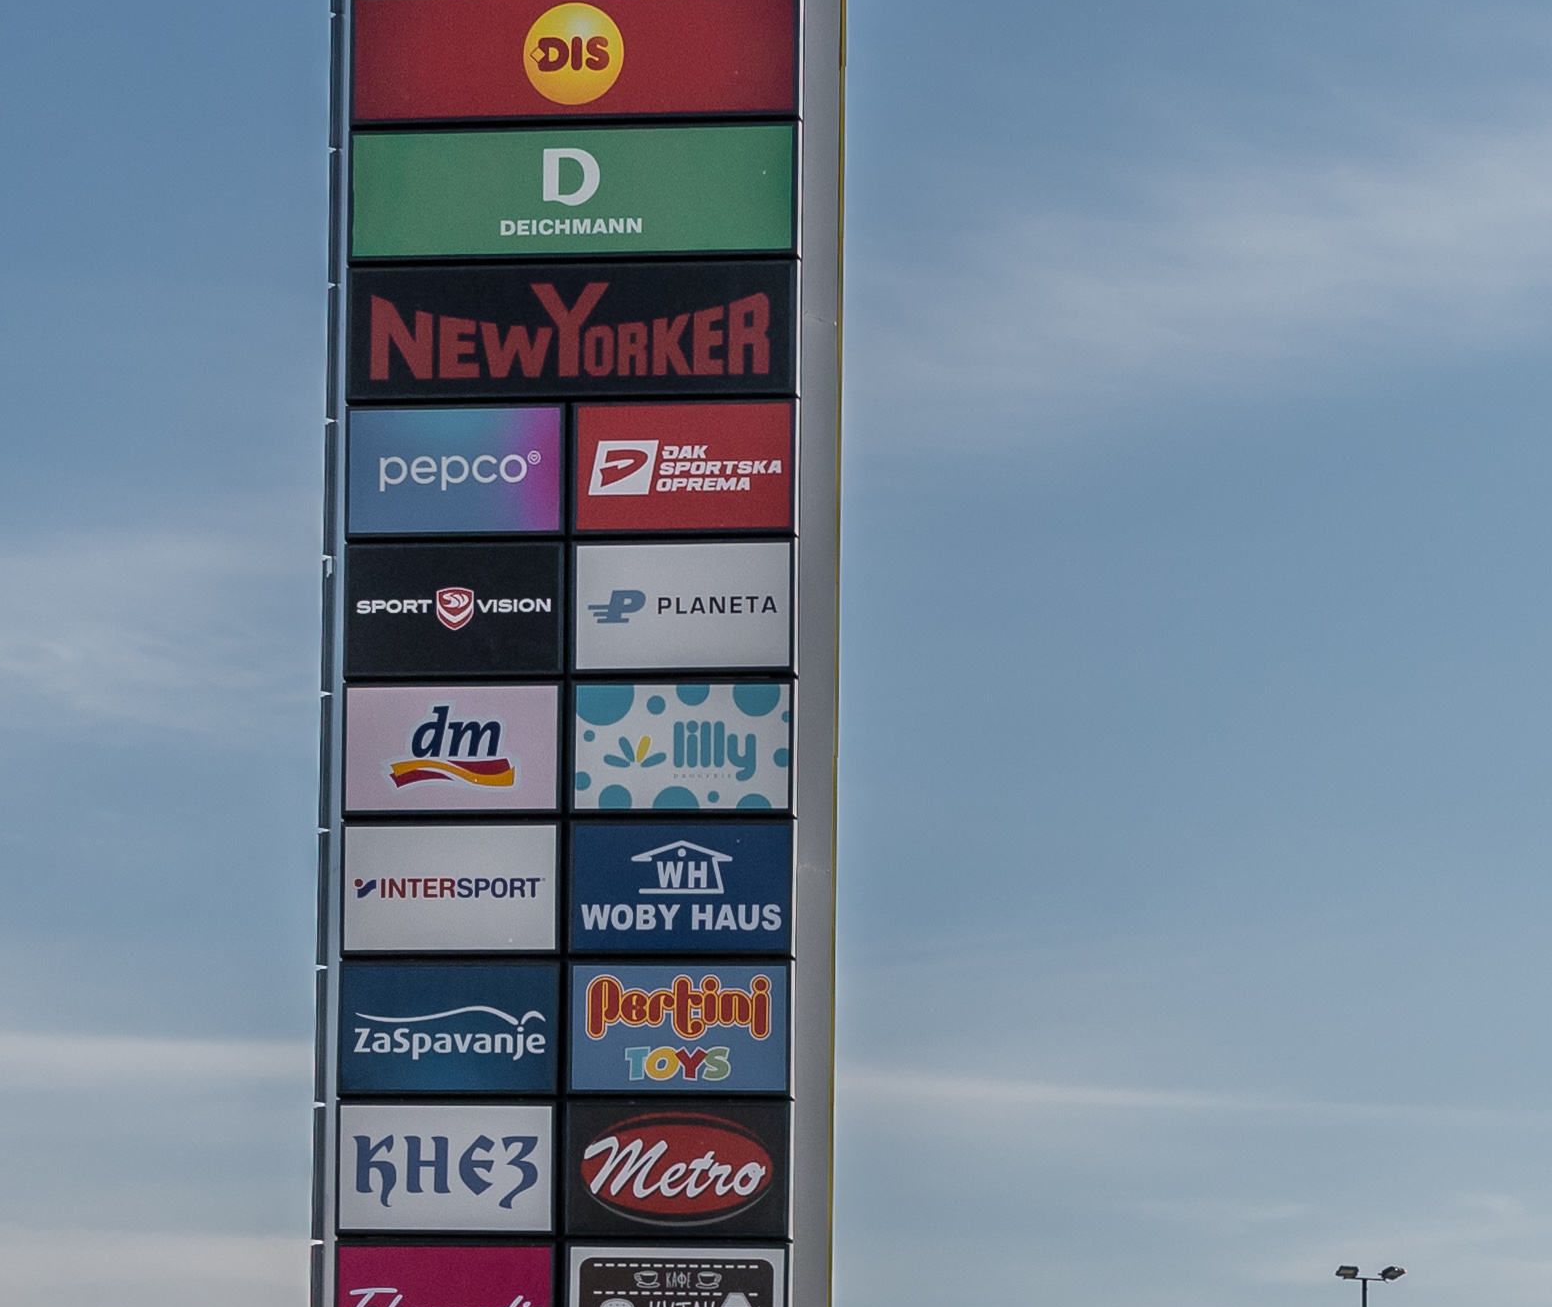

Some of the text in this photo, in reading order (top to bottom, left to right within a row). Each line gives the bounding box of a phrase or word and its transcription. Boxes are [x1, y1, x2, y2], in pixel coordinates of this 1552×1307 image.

[531, 35, 610, 72] DIS
[541, 147, 601, 206] D
[499, 217, 643, 237] DEICHMANN
[378, 453, 529, 492] pepco
[658, 460, 783, 476] SPORTSKA
[655, 476, 751, 492] OPREMA
[355, 597, 552, 616] SPORT VISION
[656, 595, 778, 616] PLANETA
[410, 704, 503, 759] dm
[672, 720, 758, 782] lilly
[379, 877, 542, 900] INTERSPORT
[656, 861, 709, 889] WH
[580, 902, 783, 932] WOBY HAUS
[353, 1026, 547, 1061] ZaSpavanje
[624, 1046, 732, 1082] TOYS
[582, 1135, 767, 1199] Metro
[665, 1271, 692, 1289] КАФЕ
